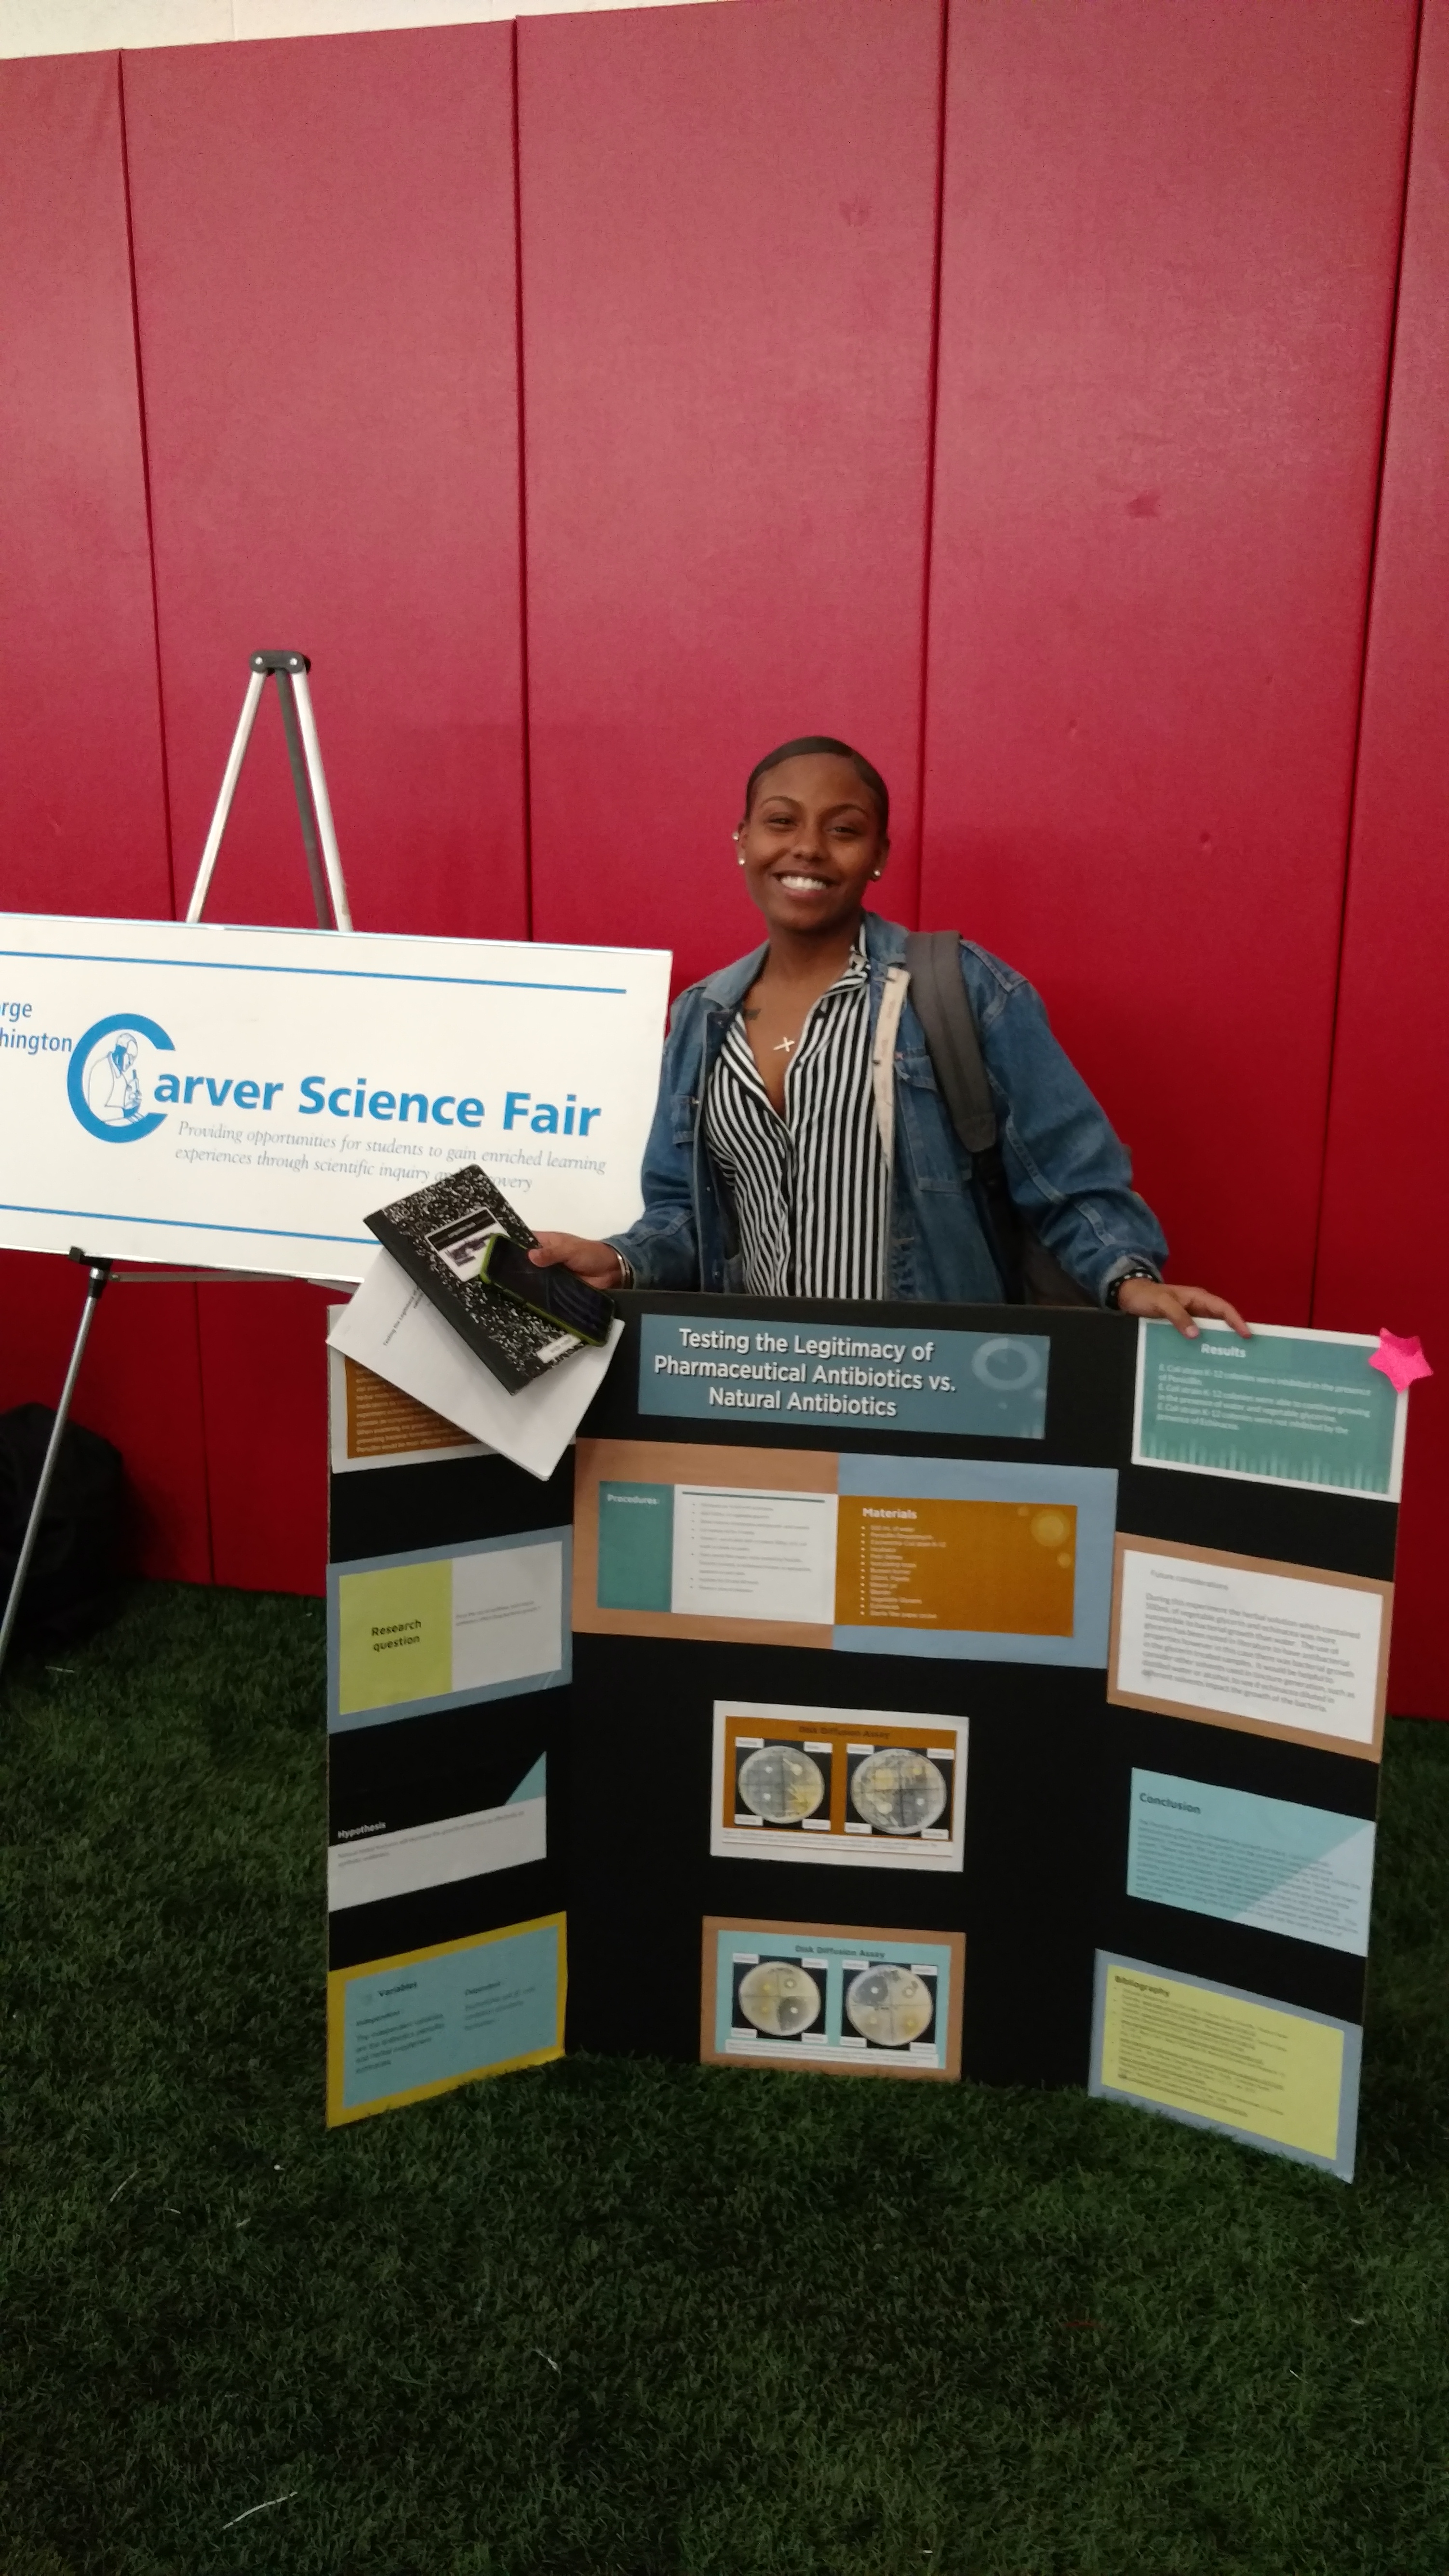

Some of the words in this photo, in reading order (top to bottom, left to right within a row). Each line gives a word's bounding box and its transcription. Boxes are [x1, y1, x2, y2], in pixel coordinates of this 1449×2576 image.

[0, 1002, 32, 1022] rge
[298, 1075, 485, 1128] Science
[502, 1091, 602, 1137] Fair
[178, 1120, 242, 1143] Providing
[247, 1130, 337, 1148] opportunities
[339, 1134, 362, 1153] for
[365, 1137, 424, 1156] students
[429, 1145, 443, 1157] to
[445, 1146, 477, 1163] gain
[482, 1148, 543, 1166] enriched
[546, 1151, 607, 1175] learning
[175, 1147, 252, 1165] experiences
[257, 1151, 309, 1172] through
[313, 1158, 375, 1178] scientific
[379, 1162, 430, 1183] inquiry
[678, 1328, 750, 1355] Testing
[755, 1332, 789, 1353] the
[794, 1334, 907, 1364] Legitimacy
[911, 1341, 935, 1361] of
[1201, 1343, 1247, 1358] Results
[654, 1354, 807, 1383] Pharmaceutical
[811, 1364, 924, 1390] Antibiotics
[928, 1375, 957, 1392] vs.
[708, 1386, 782, 1410] Natural
[786, 1391, 899, 1417] Antibiotics
[862, 1507, 918, 1519] Materials
[371, 1619, 422, 1637] Research
[373, 1636, 421, 1653] question
[1139, 1792, 1201, 1815] Conclusion
